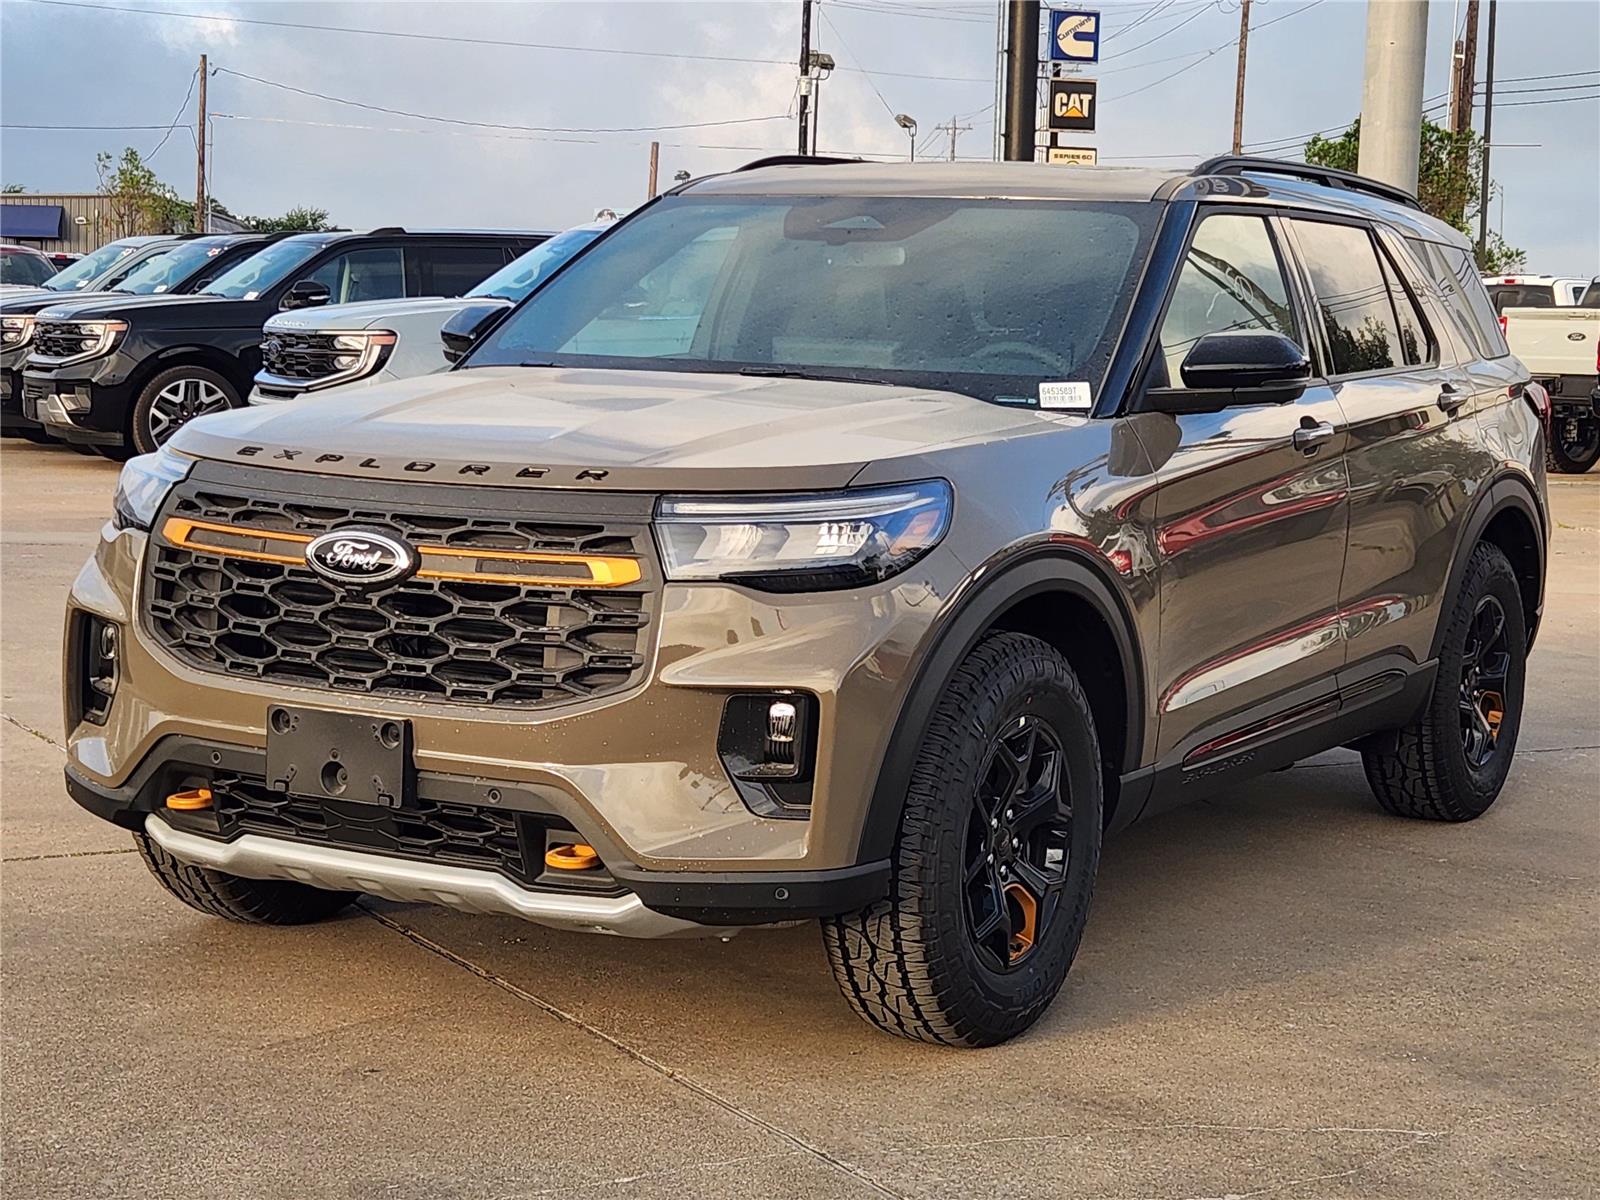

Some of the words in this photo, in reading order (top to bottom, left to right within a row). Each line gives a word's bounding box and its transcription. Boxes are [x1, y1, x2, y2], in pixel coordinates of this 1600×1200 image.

[1057, 16, 1092, 41] Cummins
[1055, 92, 1093, 118] CAT
[236, 445, 609, 482] EXPLORER
[323, 540, 382, 570] Ford
